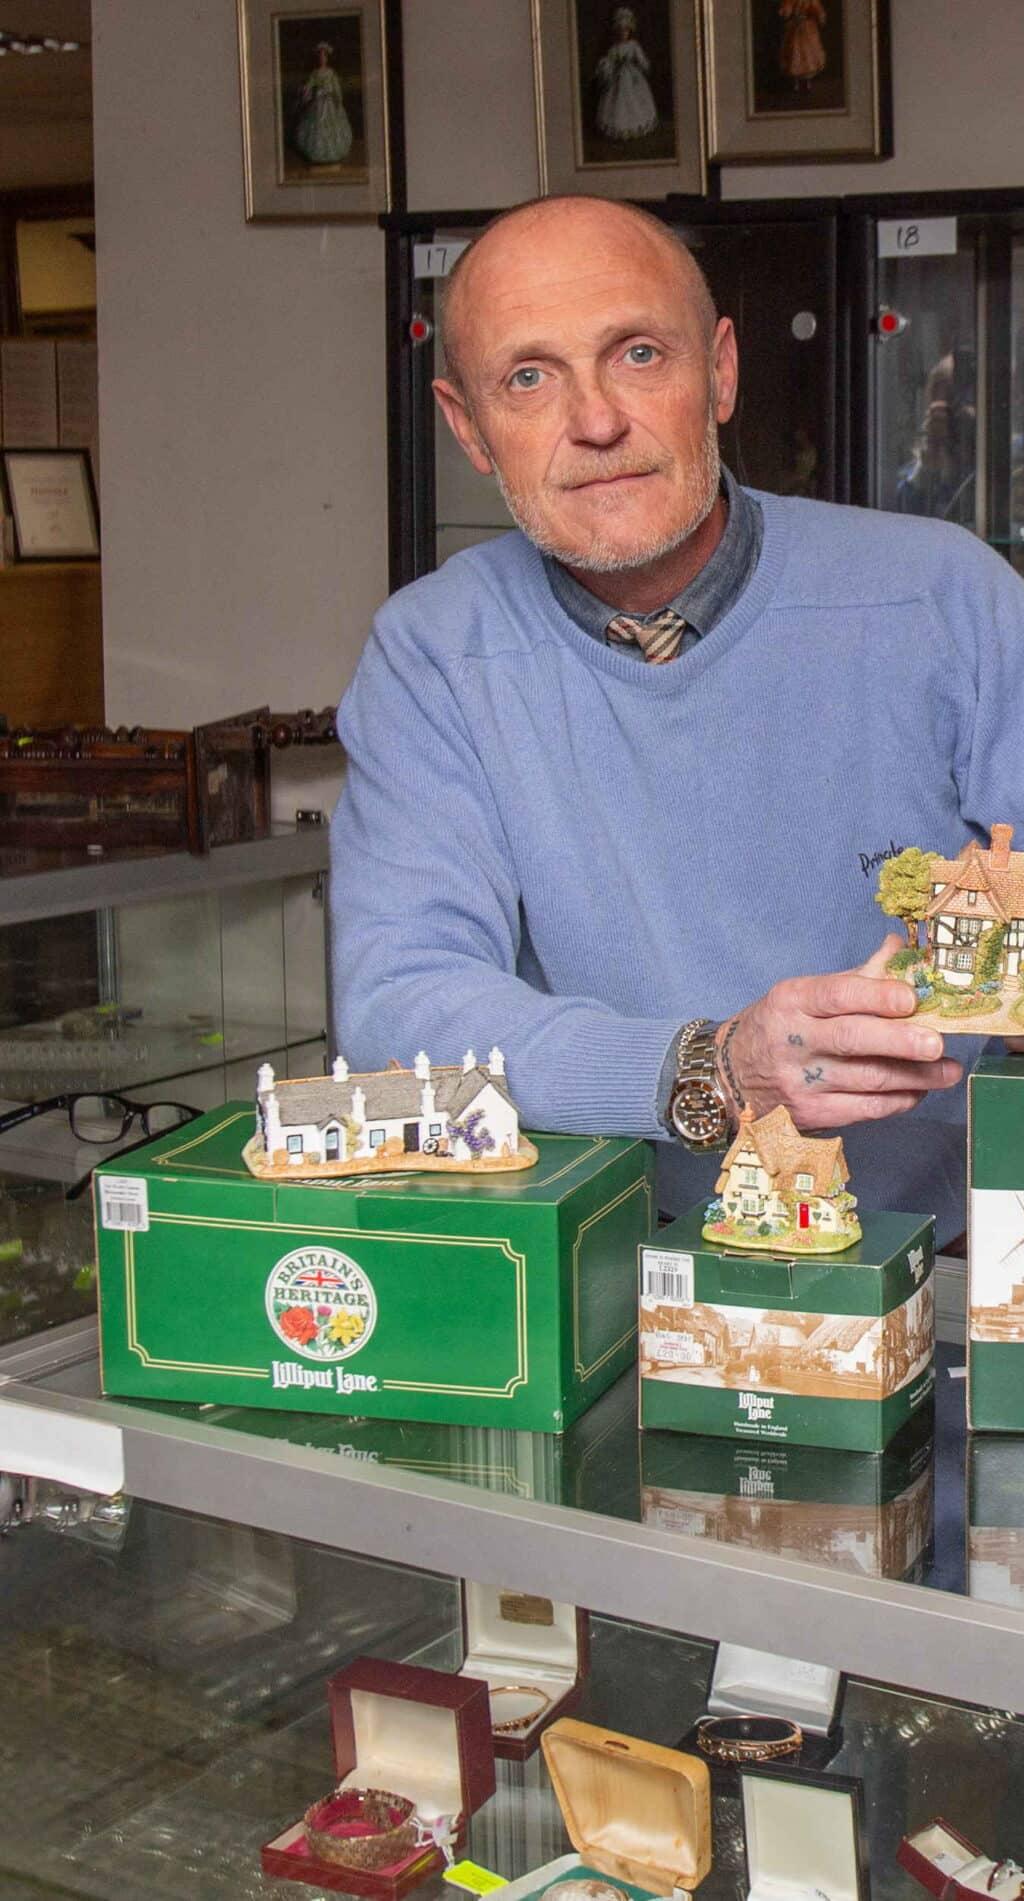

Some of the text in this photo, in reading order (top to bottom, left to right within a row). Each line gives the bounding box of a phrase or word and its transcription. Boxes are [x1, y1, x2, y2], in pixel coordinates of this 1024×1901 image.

[897, 225, 919, 249] 18
[427, 248, 447, 274] 17
[277, 1254, 364, 1291] BRITAIN'S
[274, 1287, 369, 1307] HERITAGE
[272, 1360, 378, 1394] Lilliput Lane
